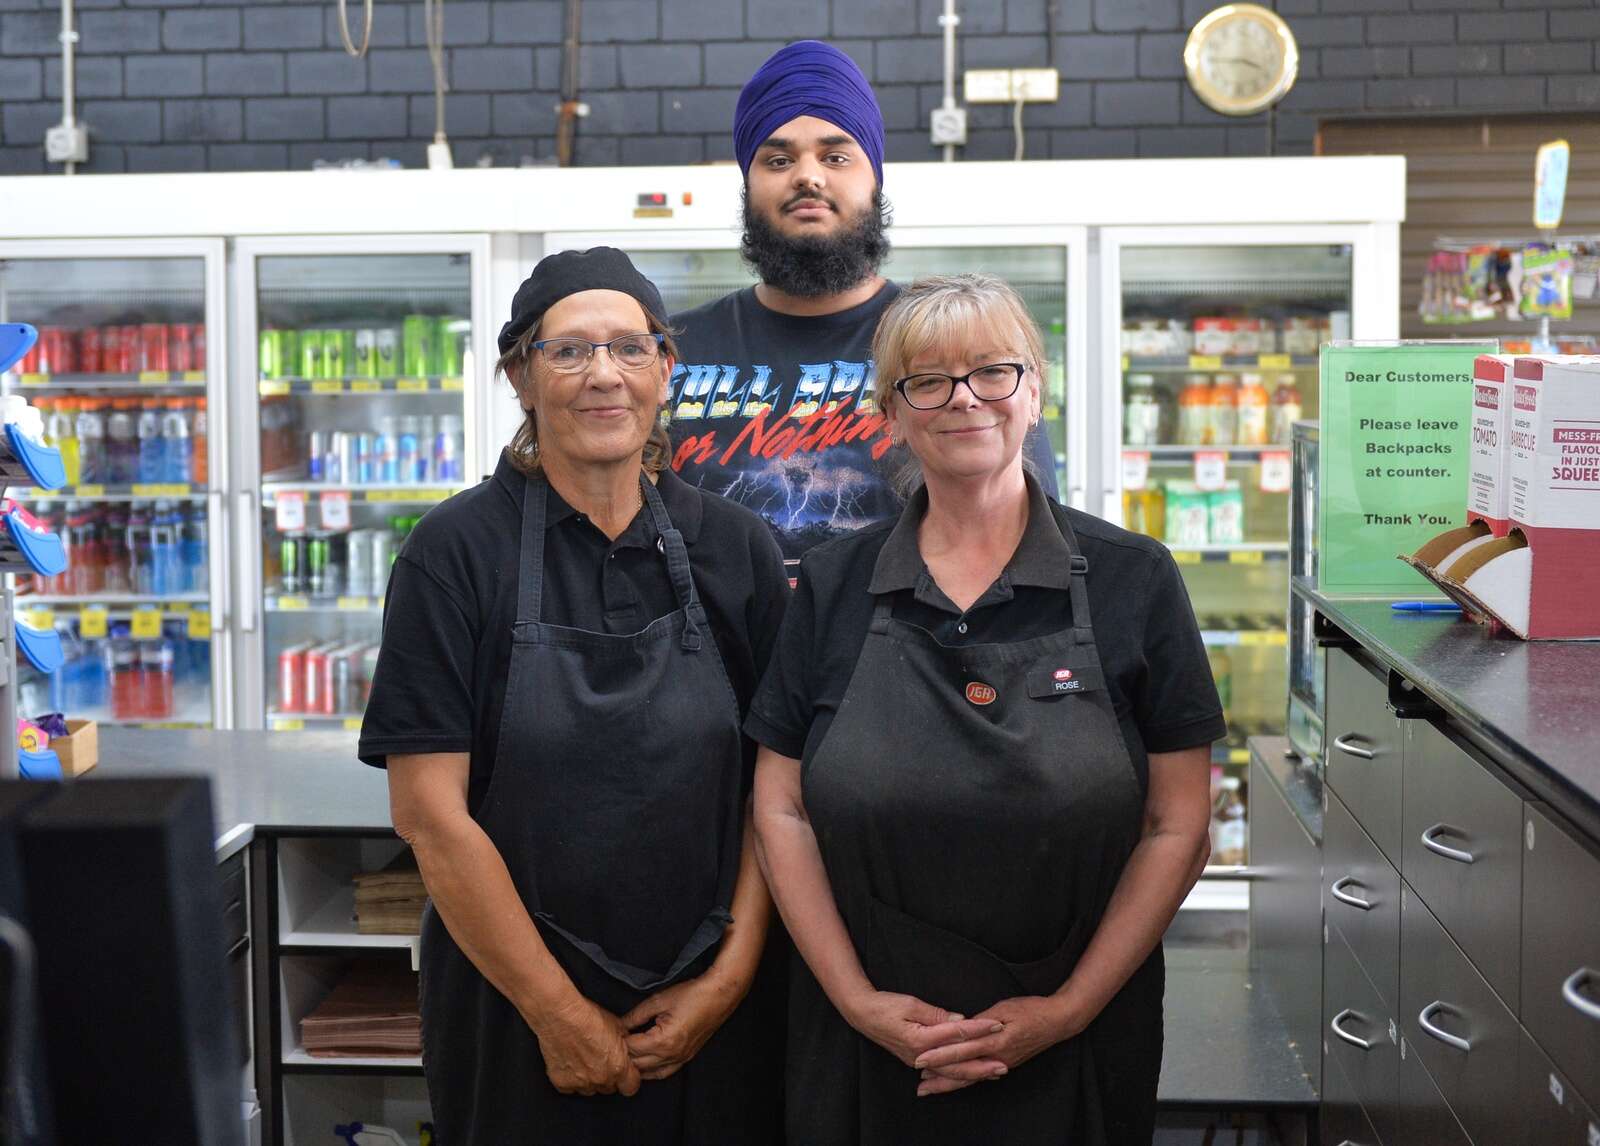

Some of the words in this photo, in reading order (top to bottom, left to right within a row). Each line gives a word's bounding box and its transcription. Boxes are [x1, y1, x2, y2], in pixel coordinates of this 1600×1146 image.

[1344, 371, 1382, 382] Dear
[1386, 371, 1474, 384] Customers,
[1359, 418, 1412, 430] Please
[1417, 418, 1459, 430] leave
[1473, 427, 1497, 447] TOMATO
[1365, 442, 1453, 456] Backpacks
[1560, 456, 1572, 466] IN
[1575, 457, 1600, 467] JUST
[1365, 466, 1382, 477] at
[1386, 466, 1452, 477] counter.
[1552, 467, 1600, 482] SQUEE
[1364, 513, 1412, 525] Thank
[1417, 513, 1452, 525] You.
[1055, 681, 1080, 691] ROSE
